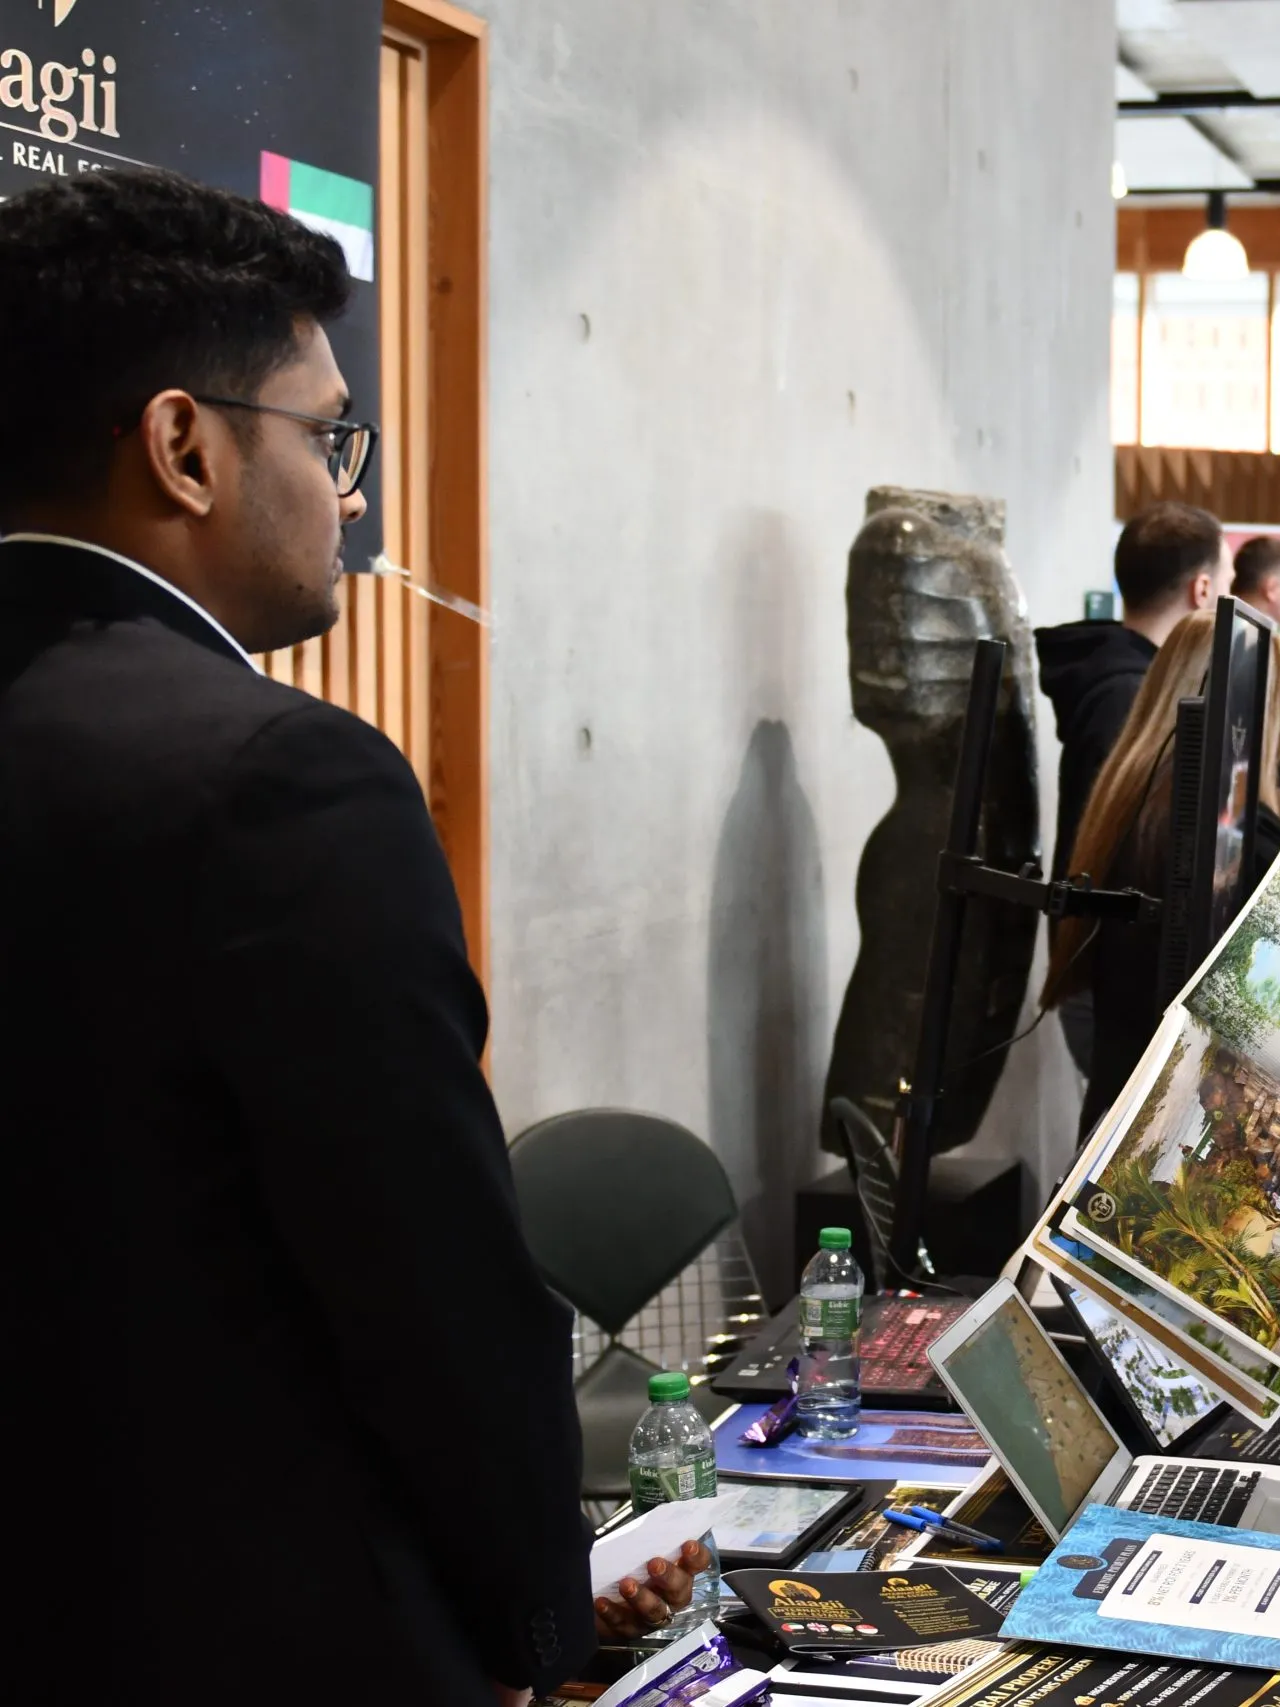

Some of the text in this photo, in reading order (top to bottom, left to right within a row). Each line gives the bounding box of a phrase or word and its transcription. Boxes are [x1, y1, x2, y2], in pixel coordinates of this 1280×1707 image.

[13, 141, 69, 176] REAL
[1234, 1567, 1255, 1585] MONTH
[881, 1584, 932, 1592] Alaagii
[1227, 1585, 1244, 1594] PER
[774, 1597, 846, 1609] Alaagii
[1026, 1681, 1061, 1700] YEARS
[1053, 1659, 1094, 1682] GOLDEN
[1102, 1669, 1130, 1686] RENTAL
[1132, 1671, 1165, 1692] PROPERTY
[970, 1690, 1012, 1707] BAI
[1146, 1685, 1178, 1707] TAX-FREE
